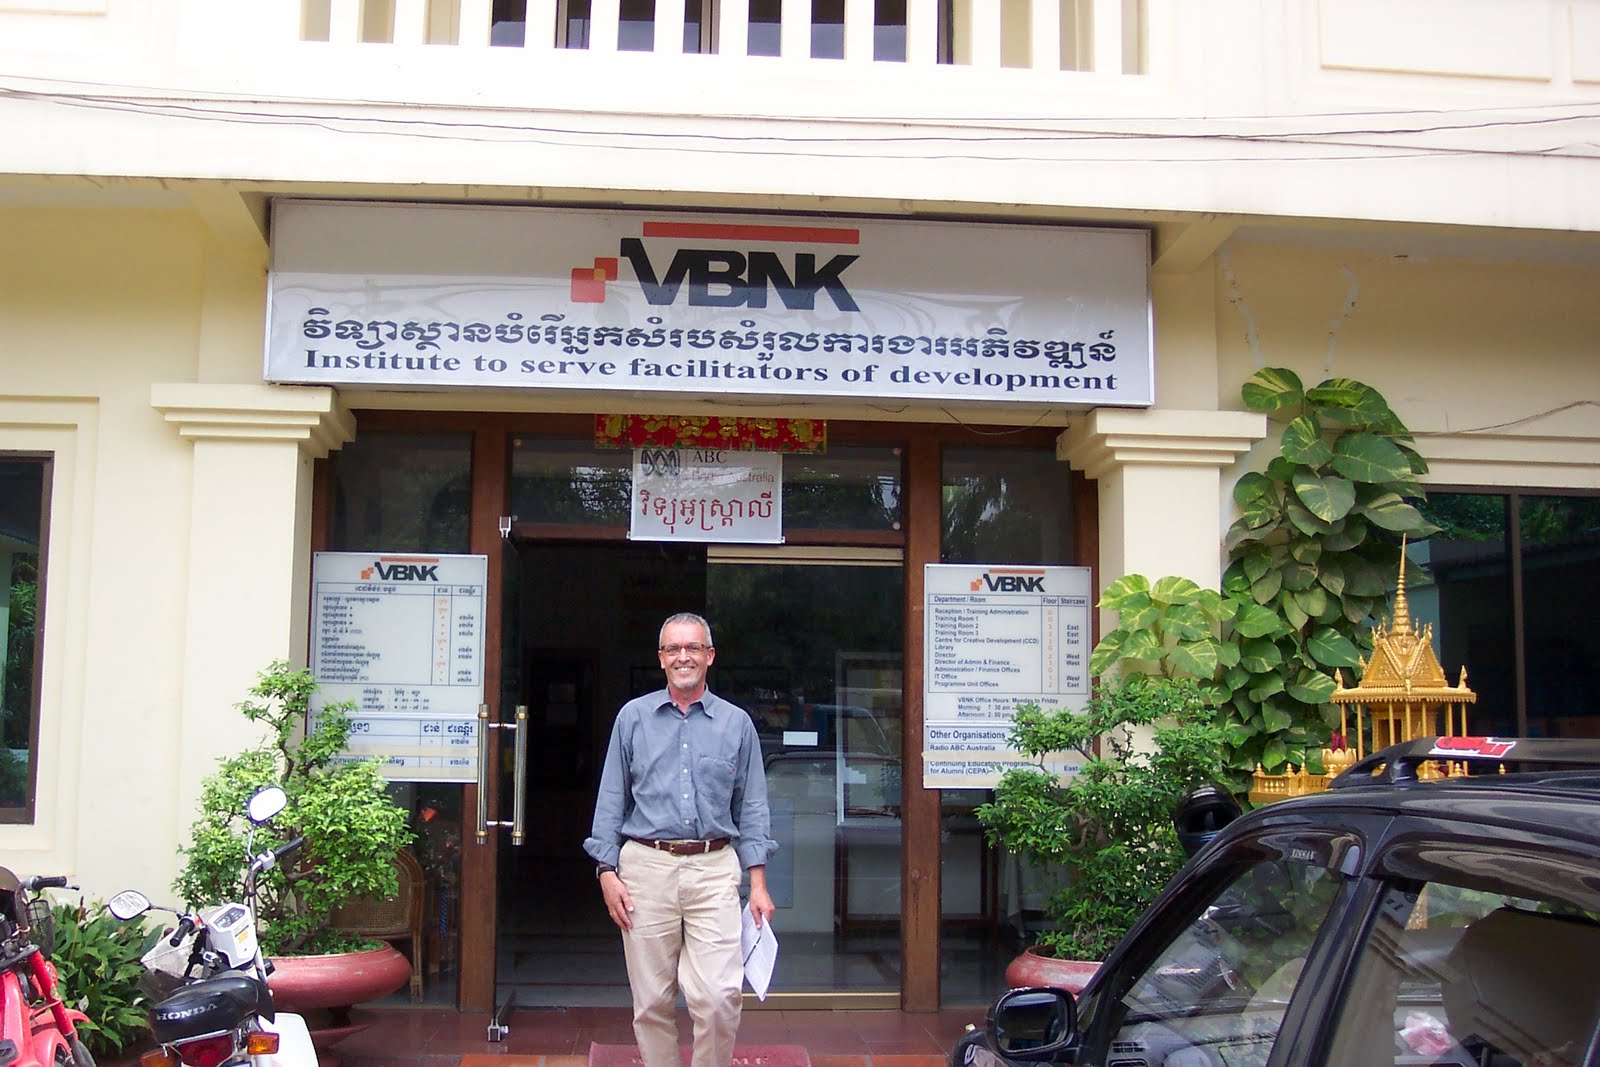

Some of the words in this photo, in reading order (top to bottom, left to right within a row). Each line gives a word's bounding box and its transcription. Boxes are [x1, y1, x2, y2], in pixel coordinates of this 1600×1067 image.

[621, 237, 861, 311] VBNK
[304, 349, 460, 371] Institute
[474, 354, 507, 373] to
[521, 359, 617, 376] serve
[629, 357, 829, 382] facilitators
[842, 364, 880, 383] of
[890, 364, 1118, 391] development
[692, 450, 727, 464] ABC
[374, 561, 439, 581] VBNK
[983, 573, 1045, 592] VBNK
[934, 596, 966, 604] Department
[934, 608, 962, 616] Reception
[966, 608, 988, 616] Training
[930, 730, 951, 739] Other
[952, 730, 1006, 740] Organisations
[156, 1003, 218, 1021] HONDA
